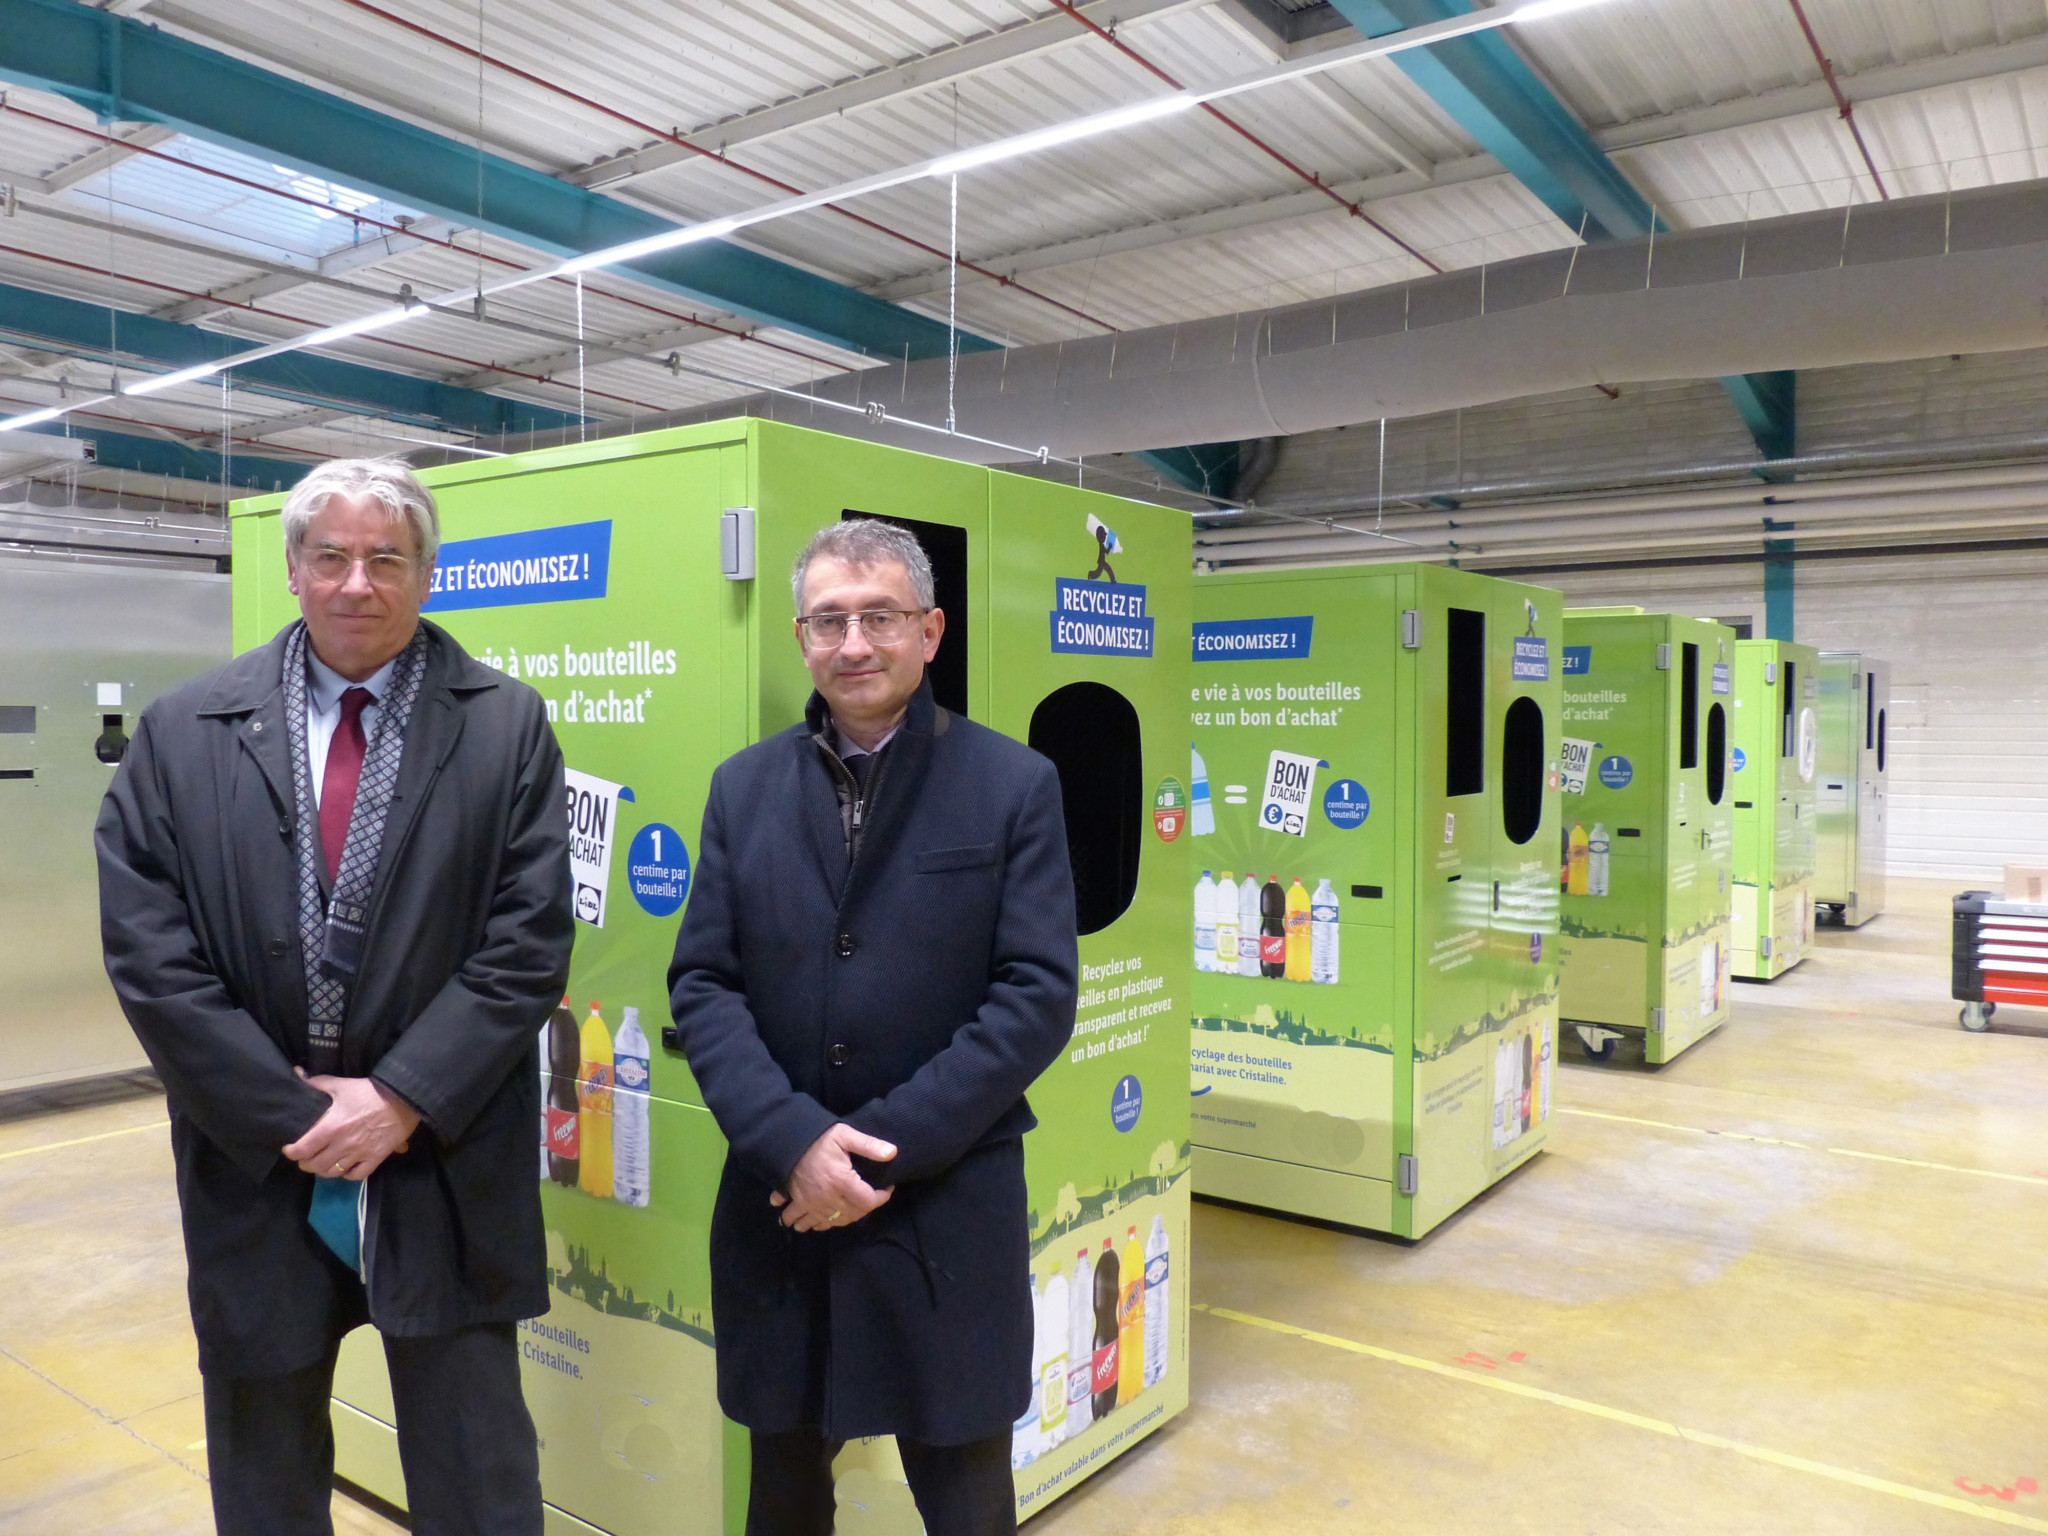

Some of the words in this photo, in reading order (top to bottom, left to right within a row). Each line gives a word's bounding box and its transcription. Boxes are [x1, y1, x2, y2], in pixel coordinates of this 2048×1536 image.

[447, 566, 465, 591] ET
[468, 555, 579, 589] ÉCONOMISEZ
[1063, 588, 1126, 616] RECYCLEZ
[1129, 597, 1142, 618] ET
[1058, 616, 1142, 650] ÉCONOMISEZ
[1198, 633, 1288, 651] ÉCONOMISEZ
[508, 648, 519, 678] à
[524, 654, 559, 677] vos
[565, 641, 676, 676] bouteilles
[1204, 683, 1227, 701] vie
[1232, 684, 1240, 701] à
[1245, 687, 1272, 701] vos
[1277, 682, 1361, 701] bouteilles
[1563, 690, 1627, 703] bouteilles
[1216, 712, 1235, 726] un
[1241, 708, 1271, 726] bon
[1562, 743, 1588, 763] BON
[1611, 758, 1618, 770] 1
[1273, 759, 1310, 790] BON
[1270, 785, 1307, 805] D'ACHAT
[1341, 783, 1349, 800] 1
[566, 785, 608, 842] BON
[1327, 801, 1354, 809] centime
[1356, 802, 1367, 811] par
[1330, 810, 1360, 819] bouteille
[651, 830, 661, 862] 1
[633, 864, 669, 880] centime
[671, 868, 687, 882] par
[637, 880, 677, 898] bouteille
[1083, 958, 1124, 983] Recyclez
[1126, 956, 1142, 971] vos
[1108, 987, 1119, 1001] en
[1122, 976, 1163, 1002] plastique
[1071, 1008, 1126, 1038] ransparent
[1129, 1005, 1138, 1020] et
[1140, 998, 1172, 1018] recevez
[1071, 1048, 1084, 1064] un
[1087, 1041, 1105, 1059] bon
[1108, 1030, 1142, 1053] d'achat
[1228, 1051, 1243, 1063] des
[1246, 1053, 1292, 1070] bouteilles
[1217, 1067, 1237, 1077] avec
[1240, 1068, 1287, 1085] Cristaline.
[1123, 1079, 1129, 1099] 1
[1217, 1117, 1256, 1128] supermarché
[532, 1318, 590, 1354] bouteilles
[524, 1341, 583, 1380] Cristaline.
[1036, 1472, 1063, 1496] d'achat
[1064, 1454, 1089, 1477] valable
[1090, 1444, 1106, 1460] dans
[1107, 1432, 1124, 1447] votre
[1125, 1400, 1164, 1437] supermarché
